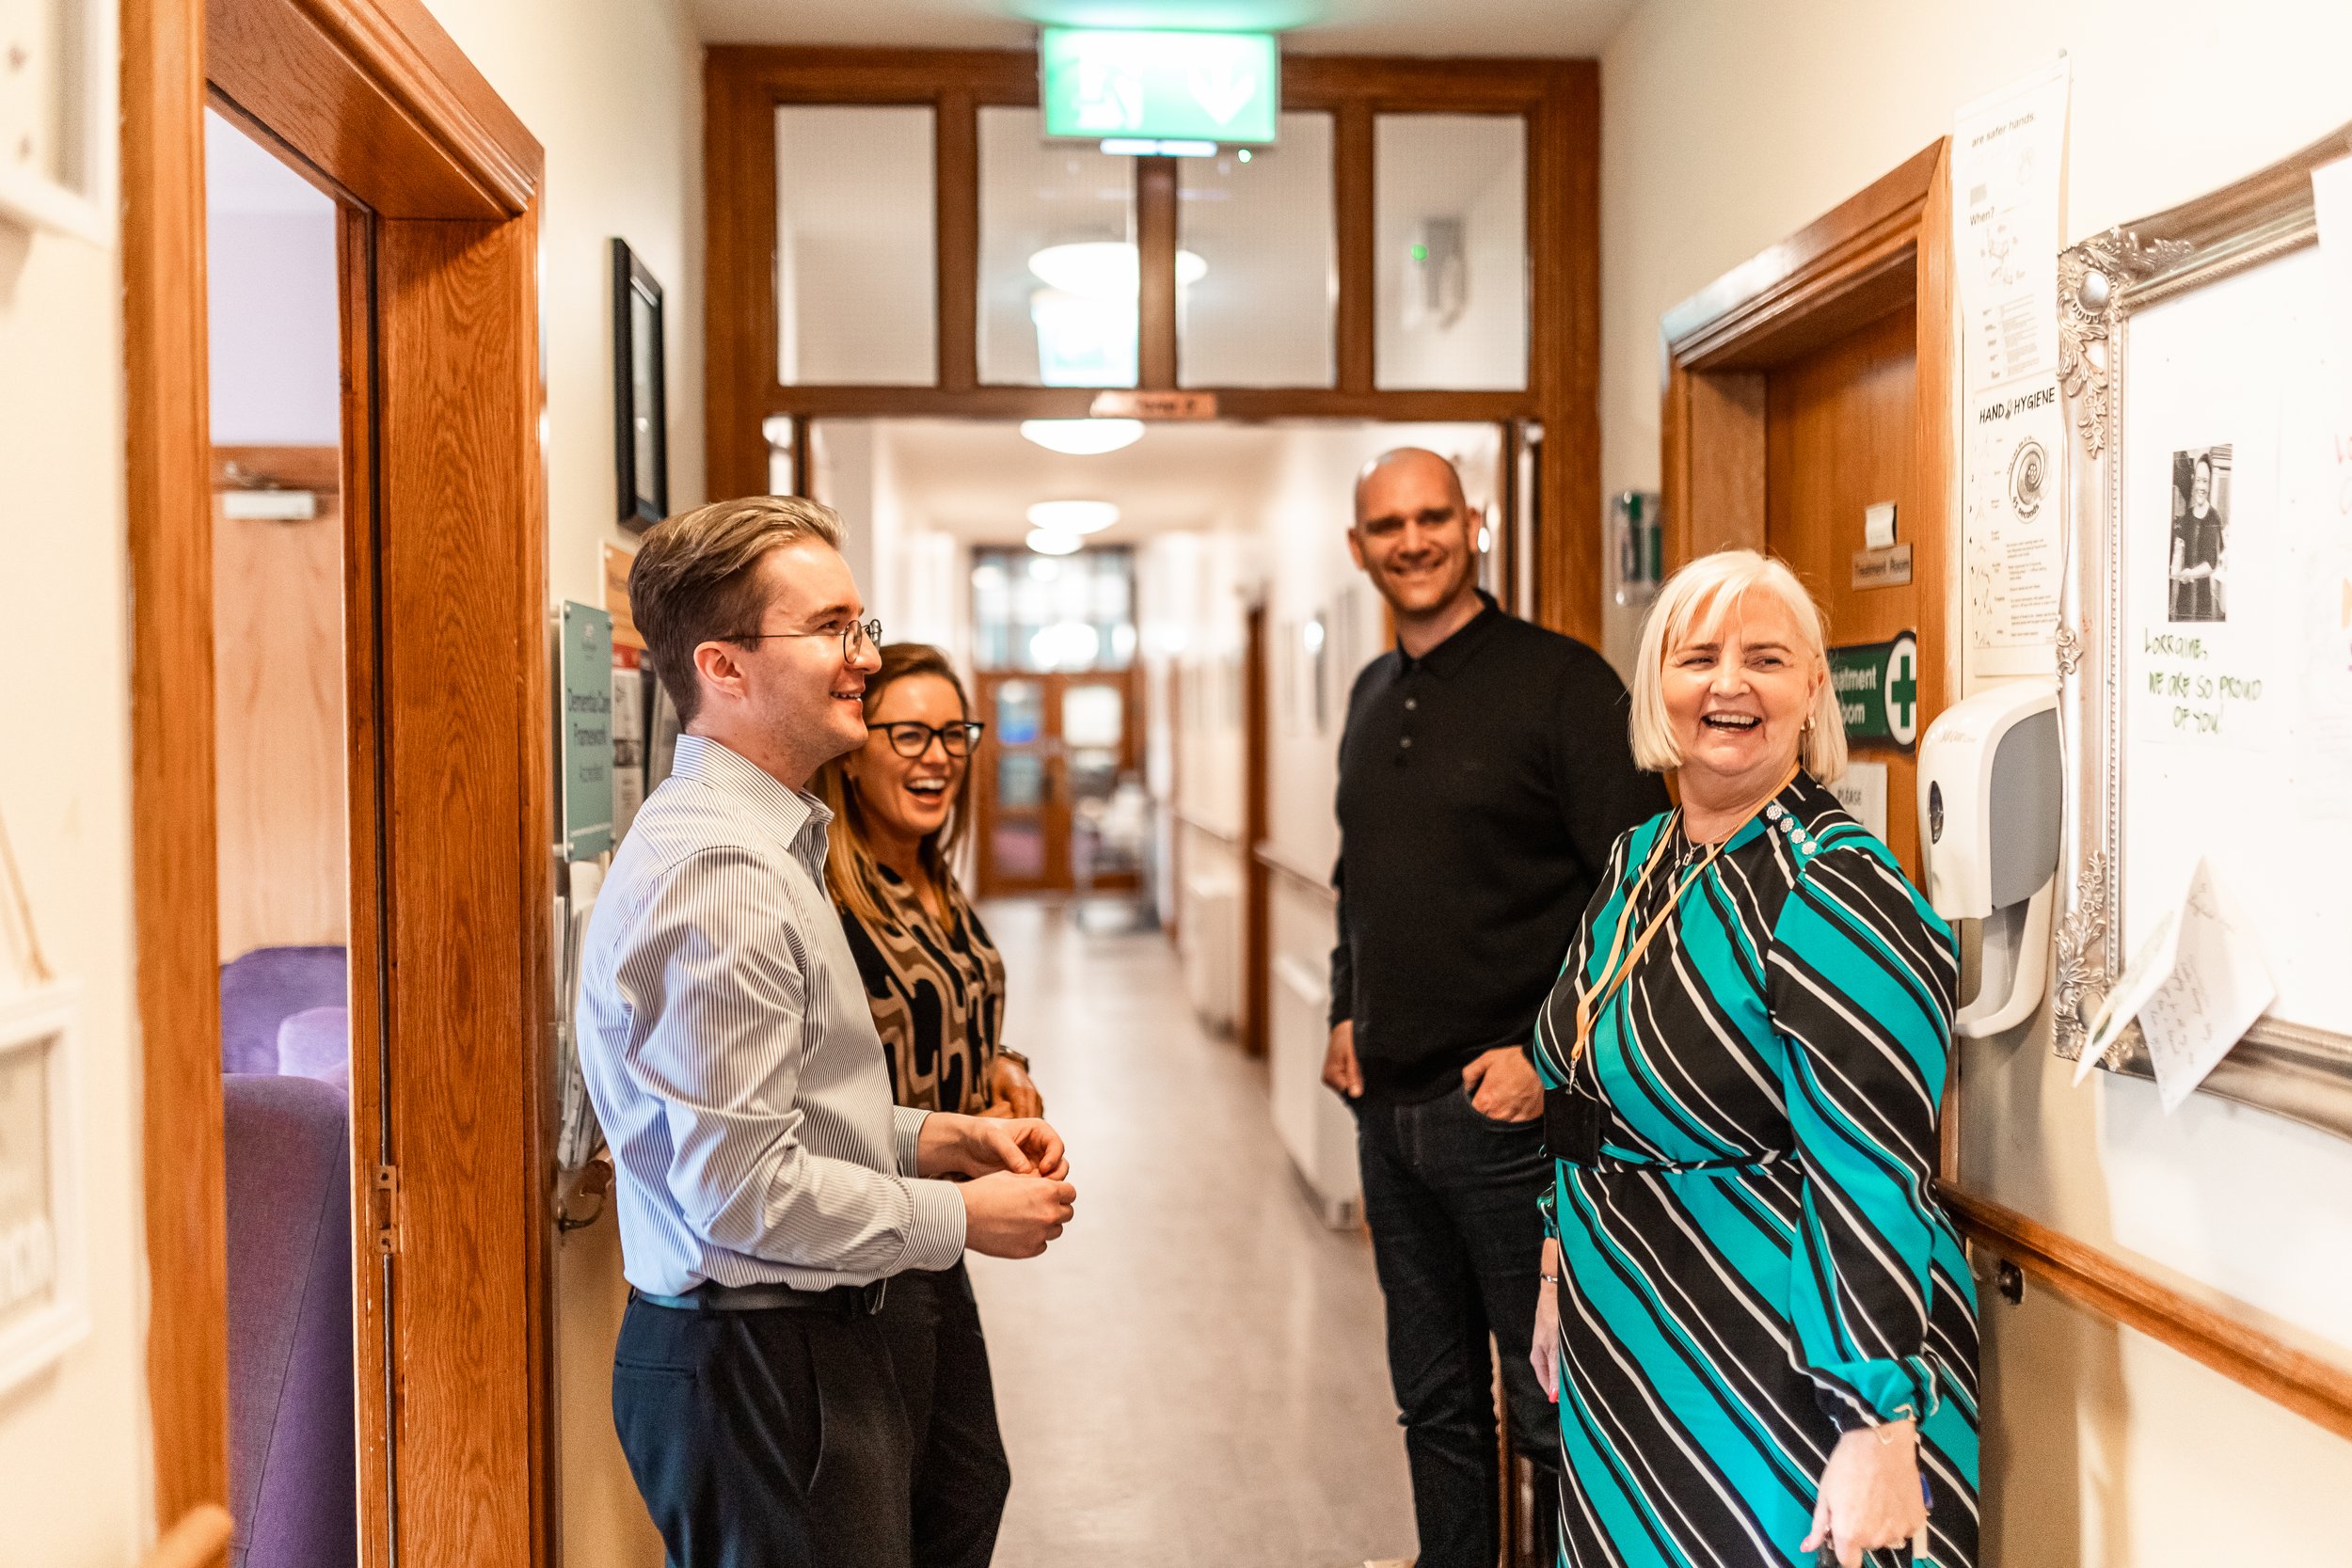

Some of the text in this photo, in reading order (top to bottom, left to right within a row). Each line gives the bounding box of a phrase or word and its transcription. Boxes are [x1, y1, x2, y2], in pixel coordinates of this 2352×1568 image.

[1971, 135, 1984, 148] are
[1986, 125, 2007, 141] safer
[1970, 206, 1994, 227] When?
[1979, 387, 2056, 425] HAND HYGIENE
[2018, 502, 2040, 519] seconds
[2196, 674, 2214, 700] SO
[2219, 674, 2264, 702] PROUD
